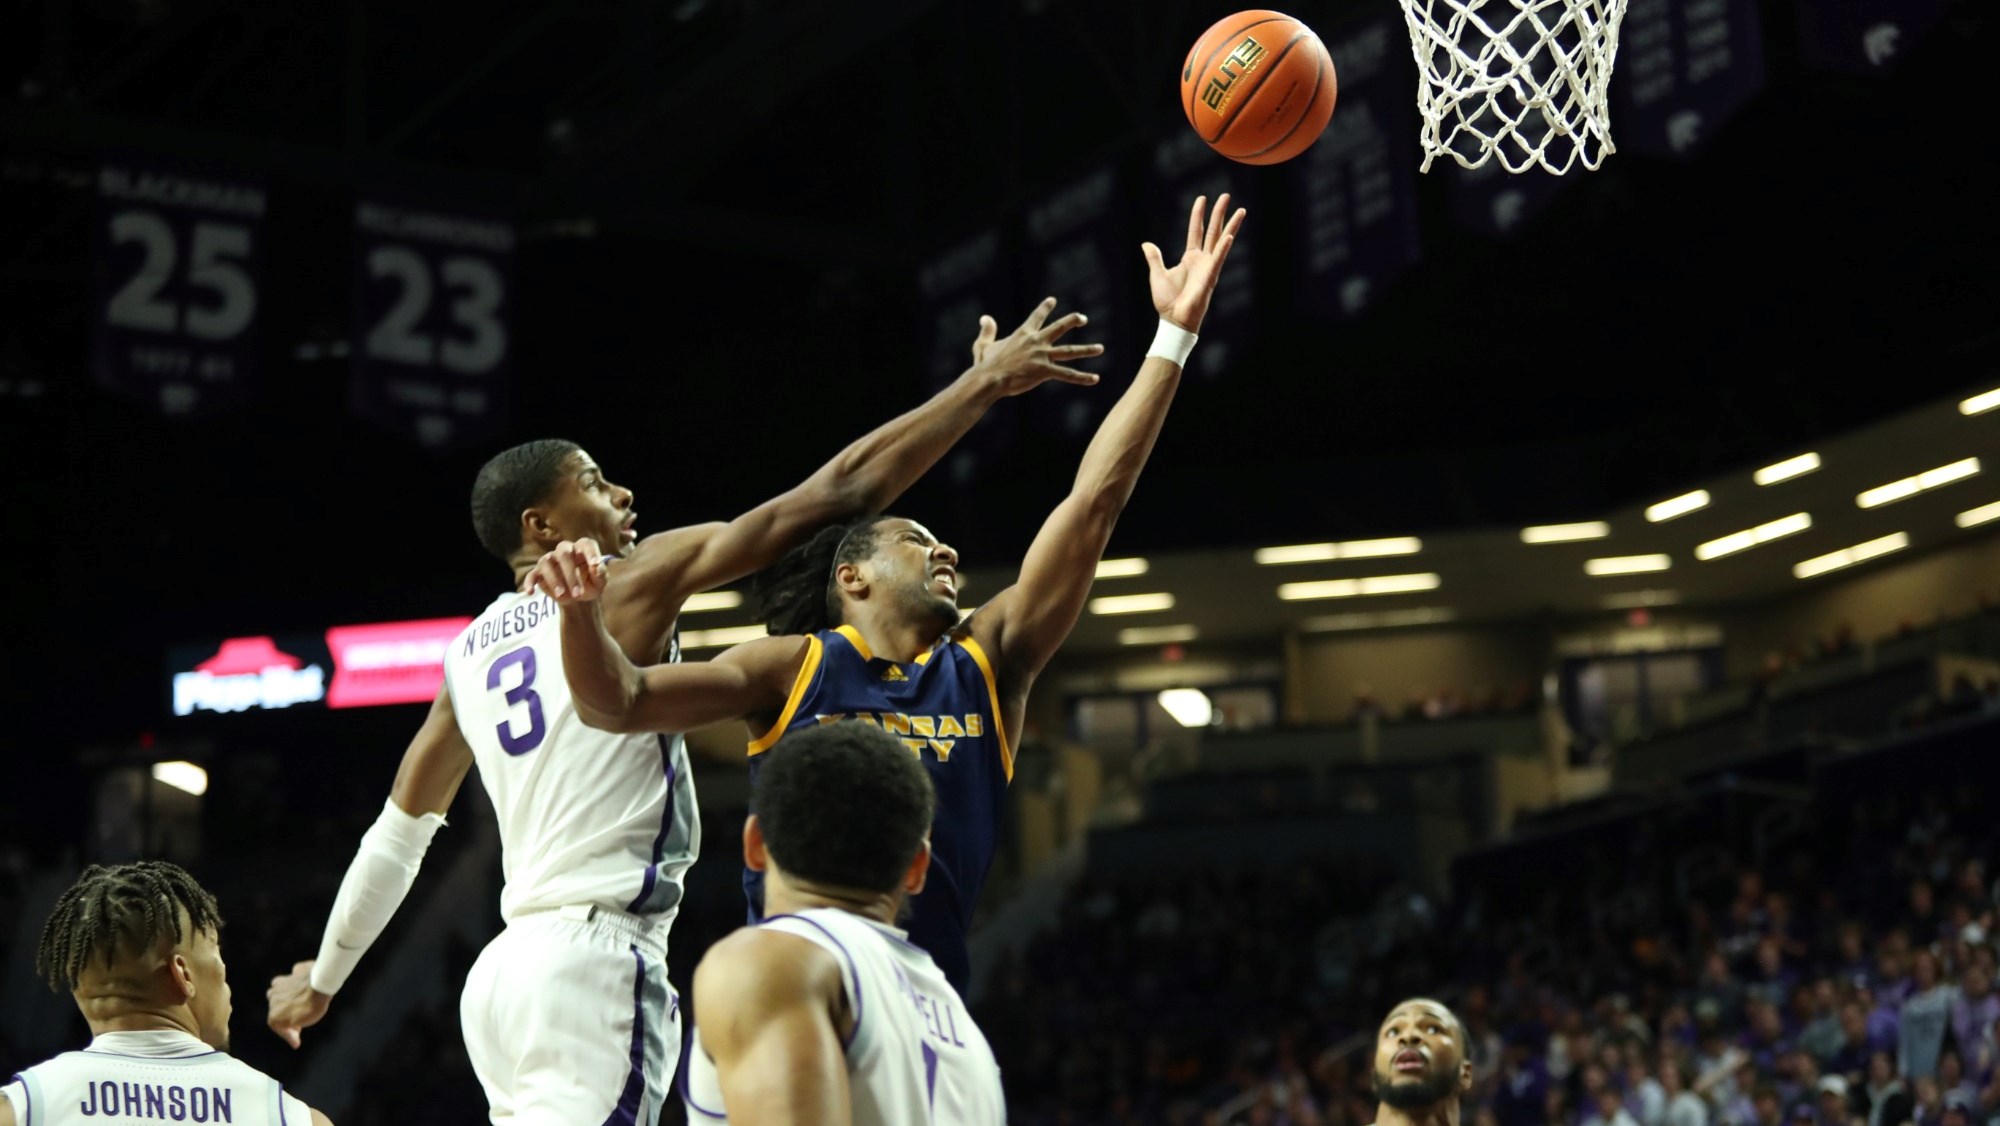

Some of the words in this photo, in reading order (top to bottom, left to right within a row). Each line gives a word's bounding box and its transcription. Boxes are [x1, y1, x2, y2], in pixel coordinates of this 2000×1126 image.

[1201, 36, 1264, 111] ELITE
[106, 209, 258, 342] 25
[363, 243, 508, 375] 23
[487, 646, 546, 757] 3
[900, 738, 956, 763] TY
[80, 1080, 233, 1124] JOHNSON
